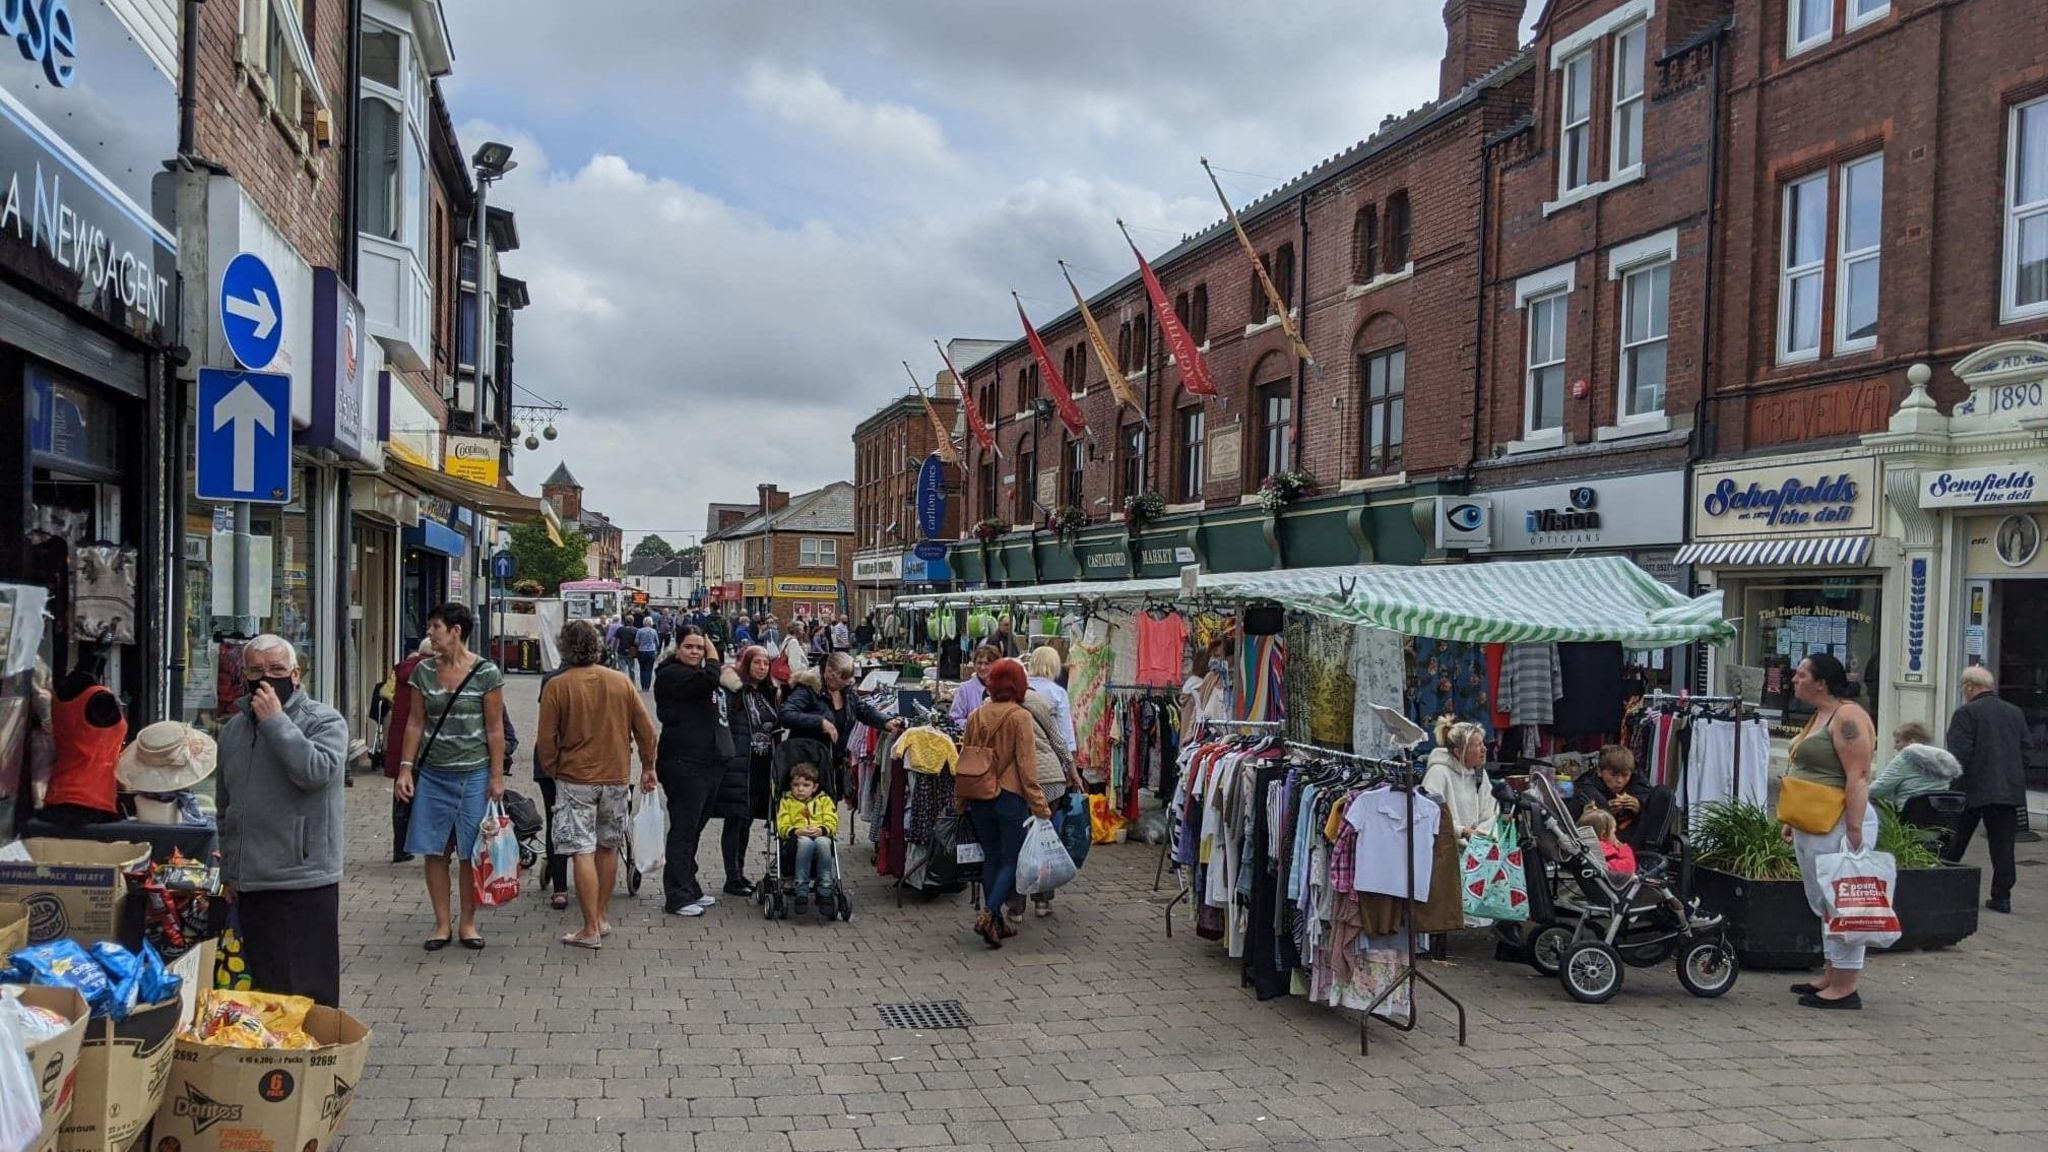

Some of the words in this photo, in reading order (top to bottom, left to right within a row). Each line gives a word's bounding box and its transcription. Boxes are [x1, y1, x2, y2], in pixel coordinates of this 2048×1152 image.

[32, 160, 169, 327] NEWSAGENT
[1705, 473, 1859, 527] Schofields
[1983, 491, 2005, 502] the
[2006, 489, 2033, 501] deli
[1525, 508, 1602, 533] iVision
[1779, 510, 1811, 526] the
[1813, 505, 1854, 523] deli
[1530, 535, 1601, 545] OPTICIANS
[1087, 552, 1126, 568] CASTLEFORD
[1141, 548, 1173, 565] MARKET
[1758, 609, 1776, 620] The
[1778, 606, 1811, 616] Tastier
[1813, 605, 1873, 624] Alternative
[174, 1050, 198, 1063] 2692
[309, 1055, 338, 1067] 92692
[270, 1074, 283, 1090] 6
[174, 1096, 244, 1122] Doritos
[59, 1125, 96, 1133] LAVOUR
